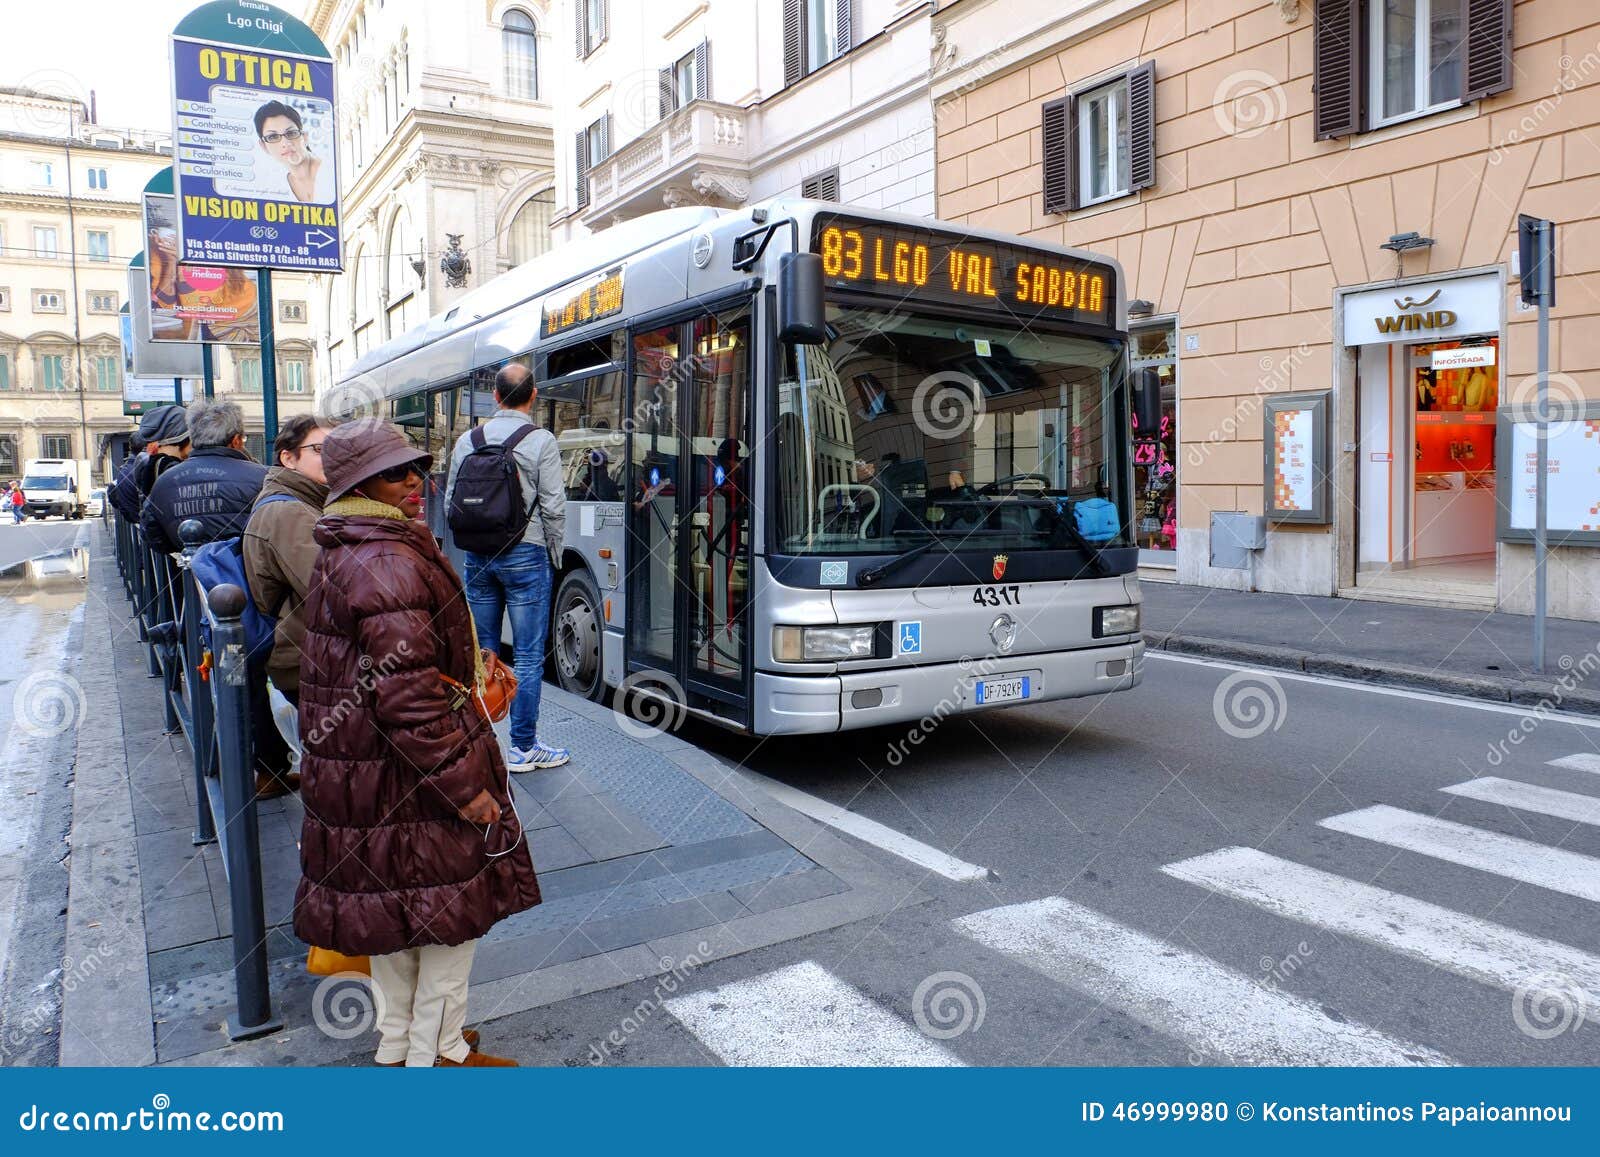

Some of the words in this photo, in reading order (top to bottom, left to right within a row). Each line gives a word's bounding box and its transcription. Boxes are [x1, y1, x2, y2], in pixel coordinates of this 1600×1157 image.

[239, 0, 270, 12] fermata
[227, 13, 252, 28] L.go
[255, 17, 284, 34] Chigi
[199, 48, 314, 93] OTTICA
[190, 103, 216, 114] Ottica
[191, 118, 247, 134] Contattologia
[191, 134, 240, 147] Optometria
[192, 149, 236, 161] Fotografia
[185, 195, 259, 221] VISION
[264, 202, 337, 227] OPTIKA
[186, 239, 203, 249] Via
[204, 240, 223, 250] San
[224, 241, 260, 252] Claudio
[262, 243, 273, 253] 87
[274, 245, 291, 255] a/b
[187, 249, 205, 260] P.za
[206, 250, 225, 260] San
[226, 251, 268, 263] Silvestro
[823, 227, 862, 279] 83
[875, 237, 928, 286] LGO
[950, 251, 996, 296] VAL
[1016, 263, 1102, 312] SABBIA
[1374, 310, 1458, 334] WIND
[1434, 356, 1485, 366] INFOSTRADA
[973, 585, 1021, 607] 4317
